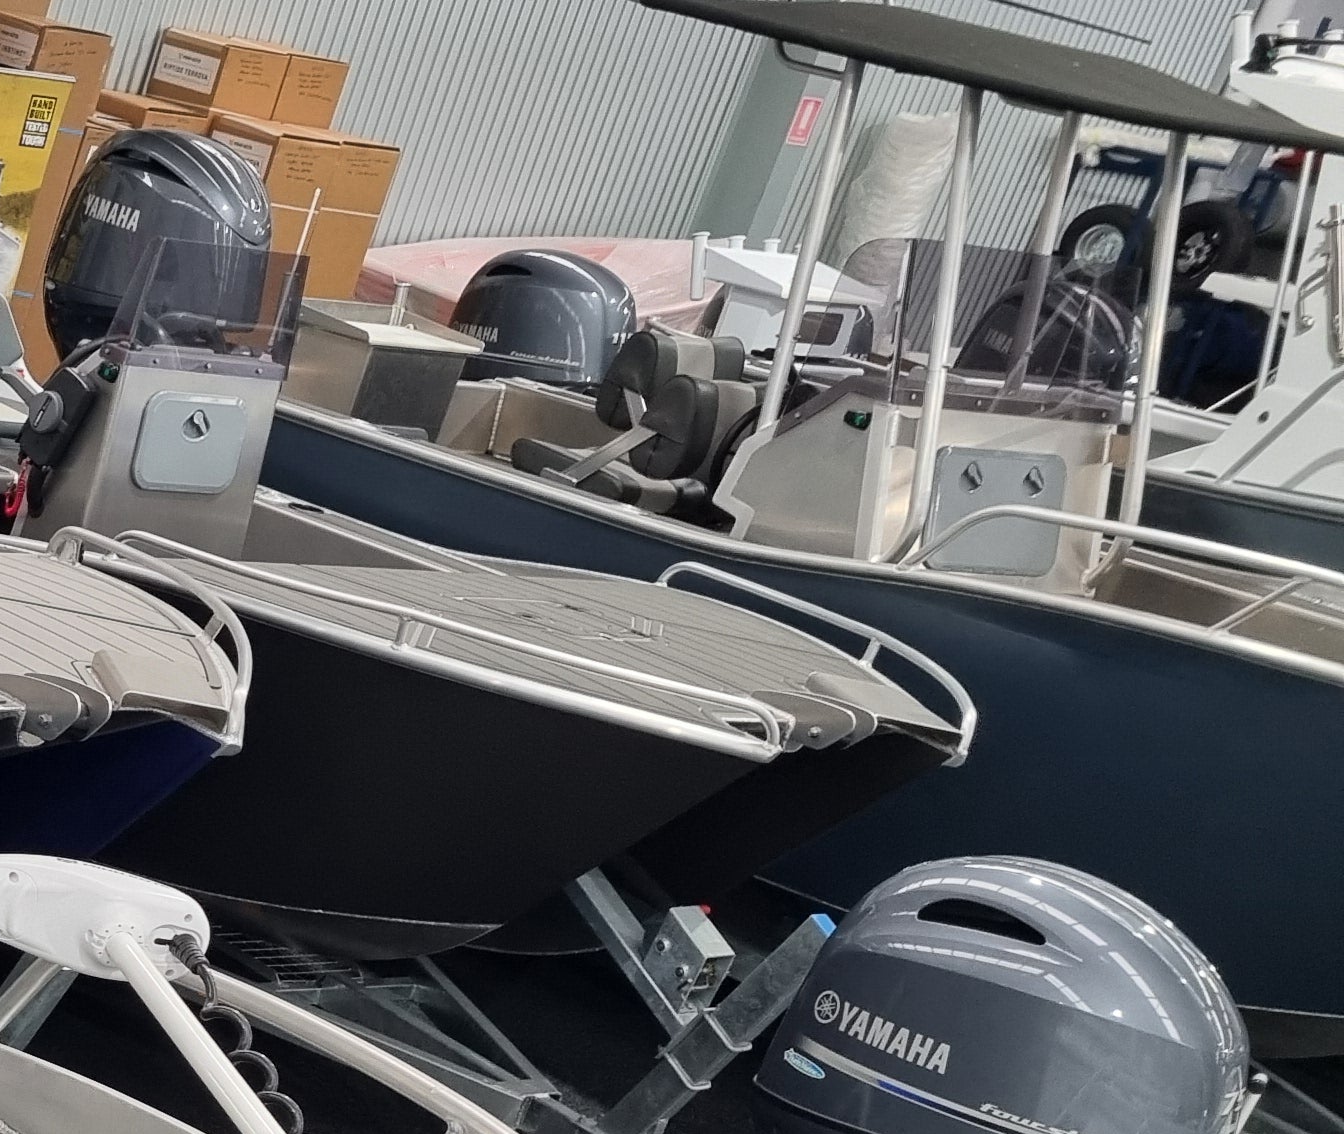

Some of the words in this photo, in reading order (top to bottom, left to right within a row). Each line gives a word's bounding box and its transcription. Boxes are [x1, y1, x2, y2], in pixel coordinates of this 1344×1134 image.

[29, 109, 52, 121] BUILT
[32, 99, 54, 110] HAND
[84, 193, 141, 233] YAMAHA
[838, 1001, 951, 1075] YAMAHA
